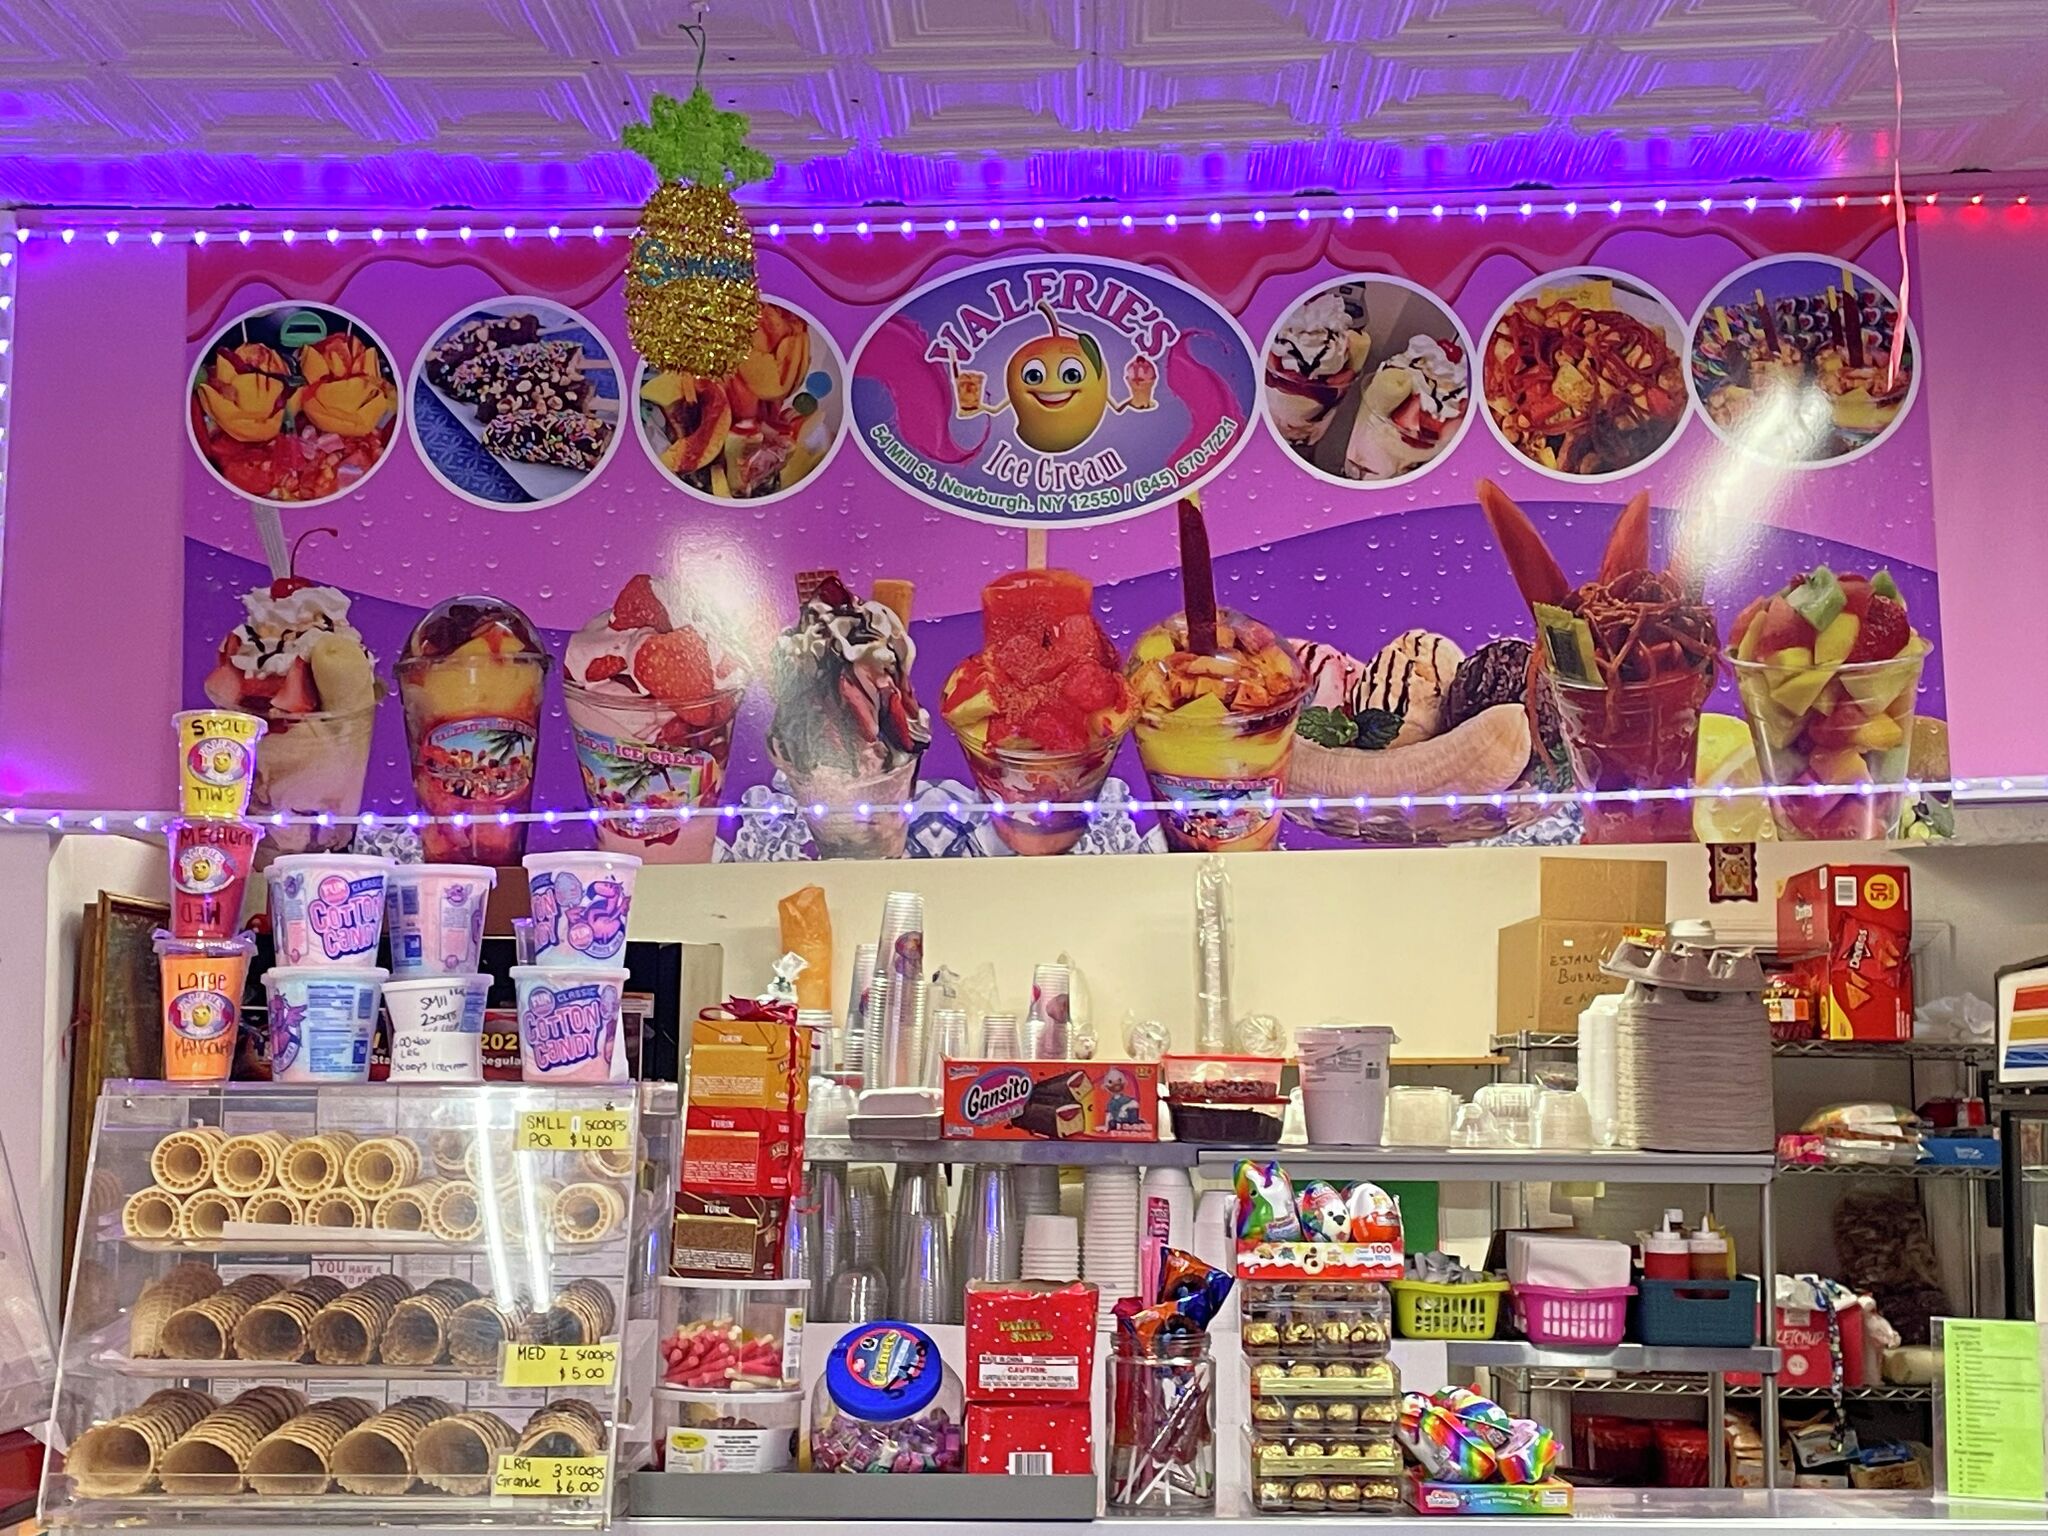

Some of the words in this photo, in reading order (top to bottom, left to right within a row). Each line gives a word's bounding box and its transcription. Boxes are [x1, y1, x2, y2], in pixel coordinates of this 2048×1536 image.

[926, 271, 1180, 359] VALERIE'S
[871, 425, 892, 447] 54
[887, 442, 918, 472] Mill
[1037, 496, 1065, 512] NY
[1071, 488, 1120, 510] 12550
[1133, 470, 1178, 501] (845)
[1176, 417, 1238, 476] 670-7221
[986, 442, 1030, 485] Ice
[1036, 449, 1126, 491] Cream
[1870, 882, 1888, 901] 50
[1849, 929, 1868, 969] Doritos
[1550, 955, 1593, 966] ESTAN
[178, 972, 227, 991] Large
[523, 998, 602, 1046] COTTON
[481, 1034, 518, 1051] 202
[966, 1076, 1030, 1119] Gansito
[711, 1119, 735, 1129] TURIN
[704, 1204, 730, 1214] TURIN
[1370, 1244, 1391, 1254] 100
[317, 1260, 346, 1274] YOU
[348, 1264, 374, 1274] HAVE
[517, 1346, 546, 1361] MED
[560, 1348, 569, 1360] 2
[503, 1458, 531, 1472] LRG
[552, 1463, 563, 1478] 3
[495, 1473, 542, 1488] Grande
